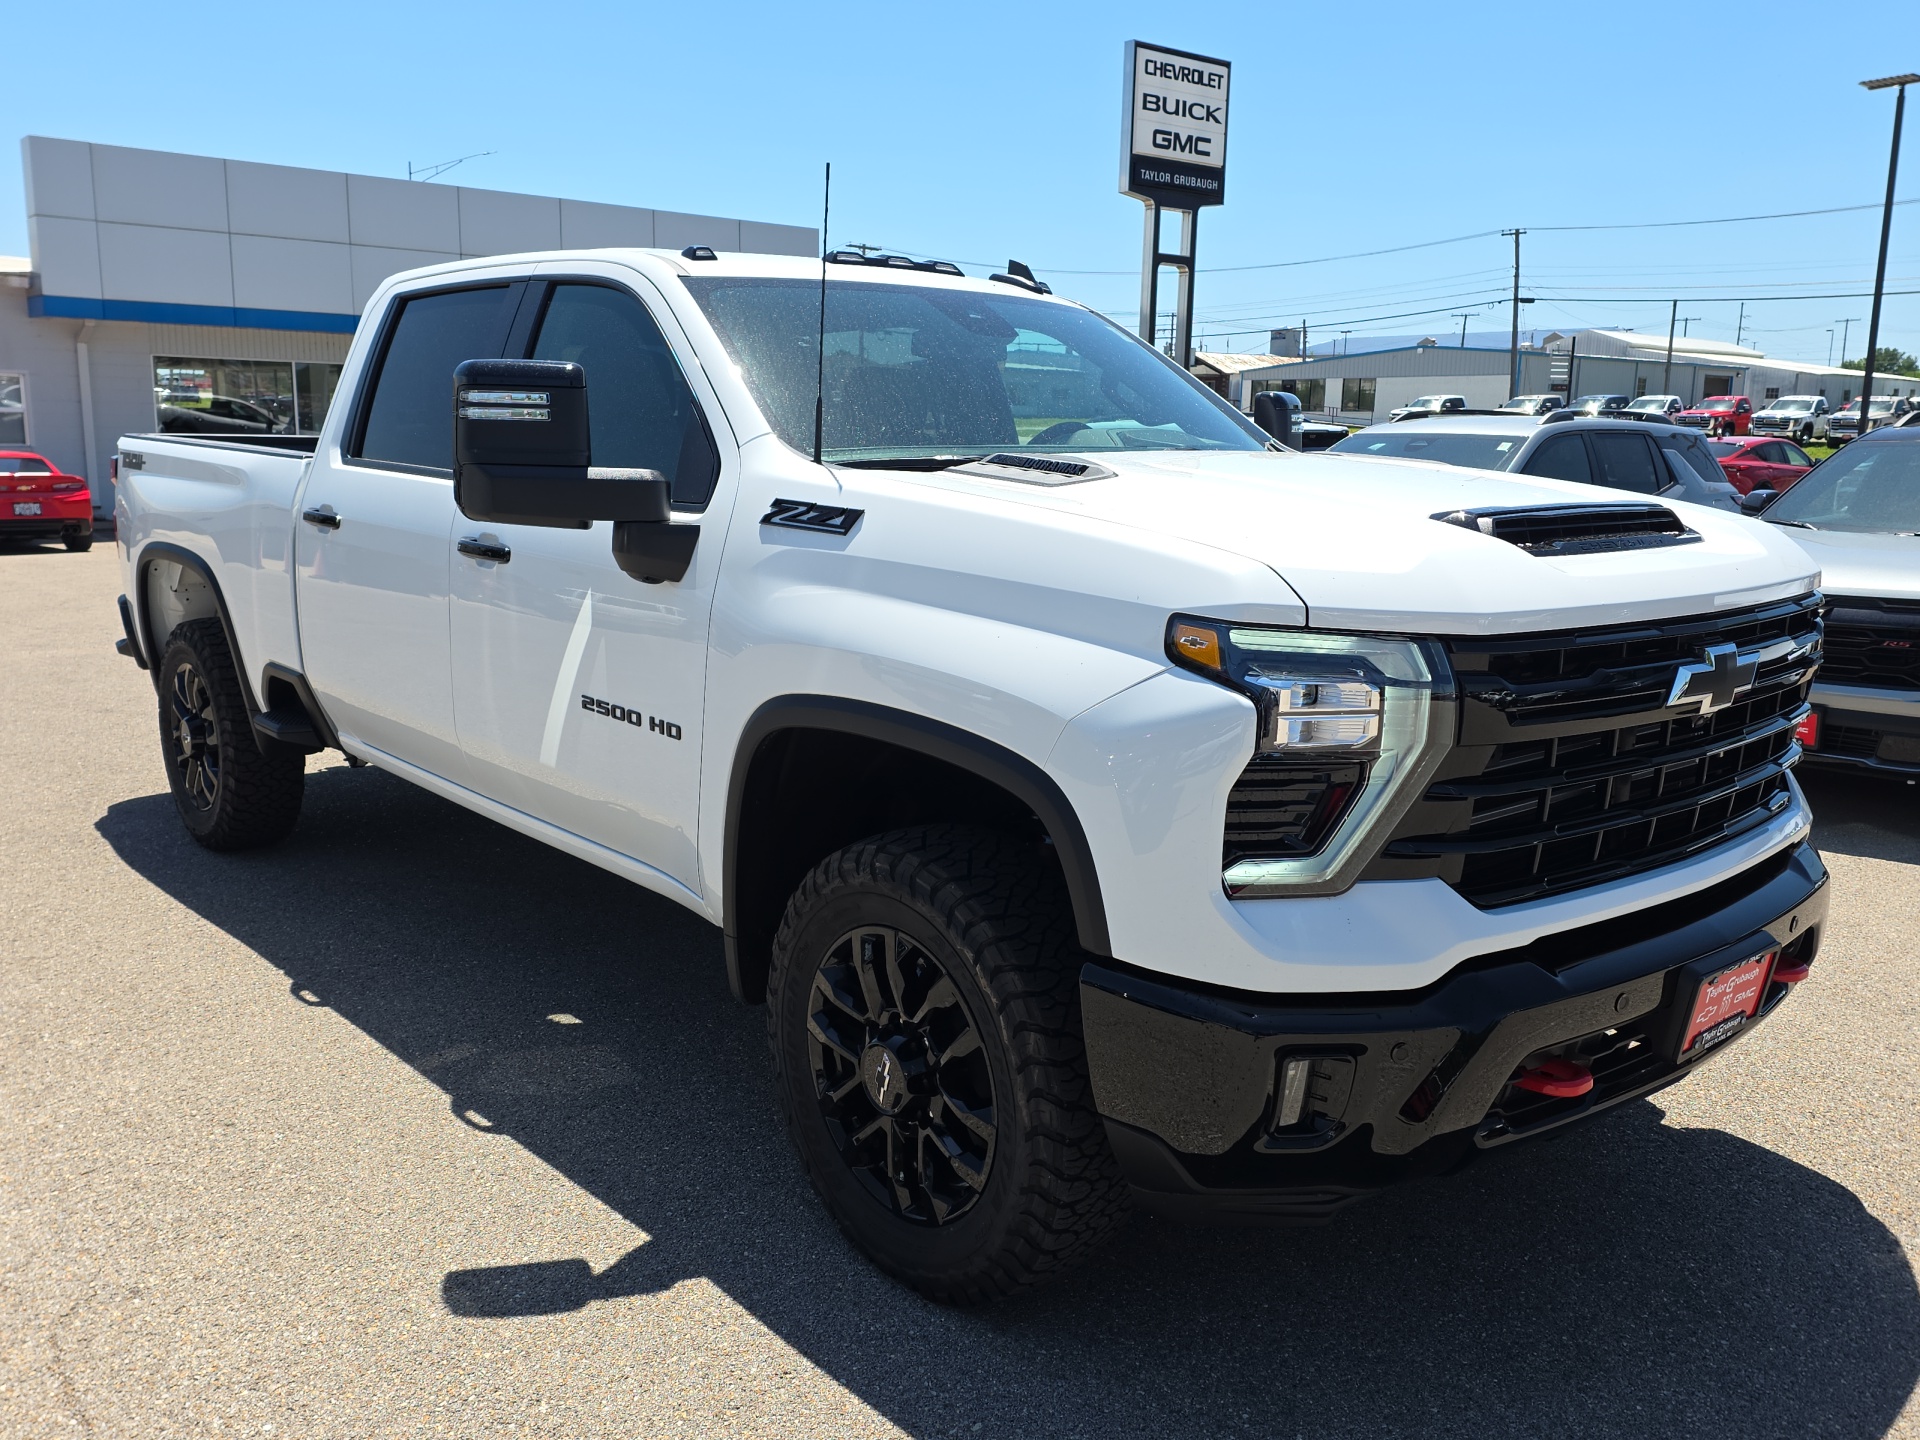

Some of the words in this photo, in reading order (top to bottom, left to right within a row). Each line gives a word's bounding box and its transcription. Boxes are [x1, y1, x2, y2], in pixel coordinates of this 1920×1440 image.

[1144, 58, 1224, 90] CHEVROLET
[1142, 92, 1222, 125] BUICK
[1152, 128, 1212, 157] GMC
[1140, 169, 1171, 183] TAYLOR
[1173, 174, 1218, 190] GRUBAUGH
[1023, 456, 1083, 476] DURAMAX
[759, 498, 865, 536] Z71
[1882, 640, 1912, 648] RS
[581, 694, 642, 727] 2500
[649, 715, 682, 741] HD
[1706, 983, 1727, 1004] Taylor
[1725, 967, 1760, 993] Grubaugh
[1733, 986, 1757, 1004] GMC
